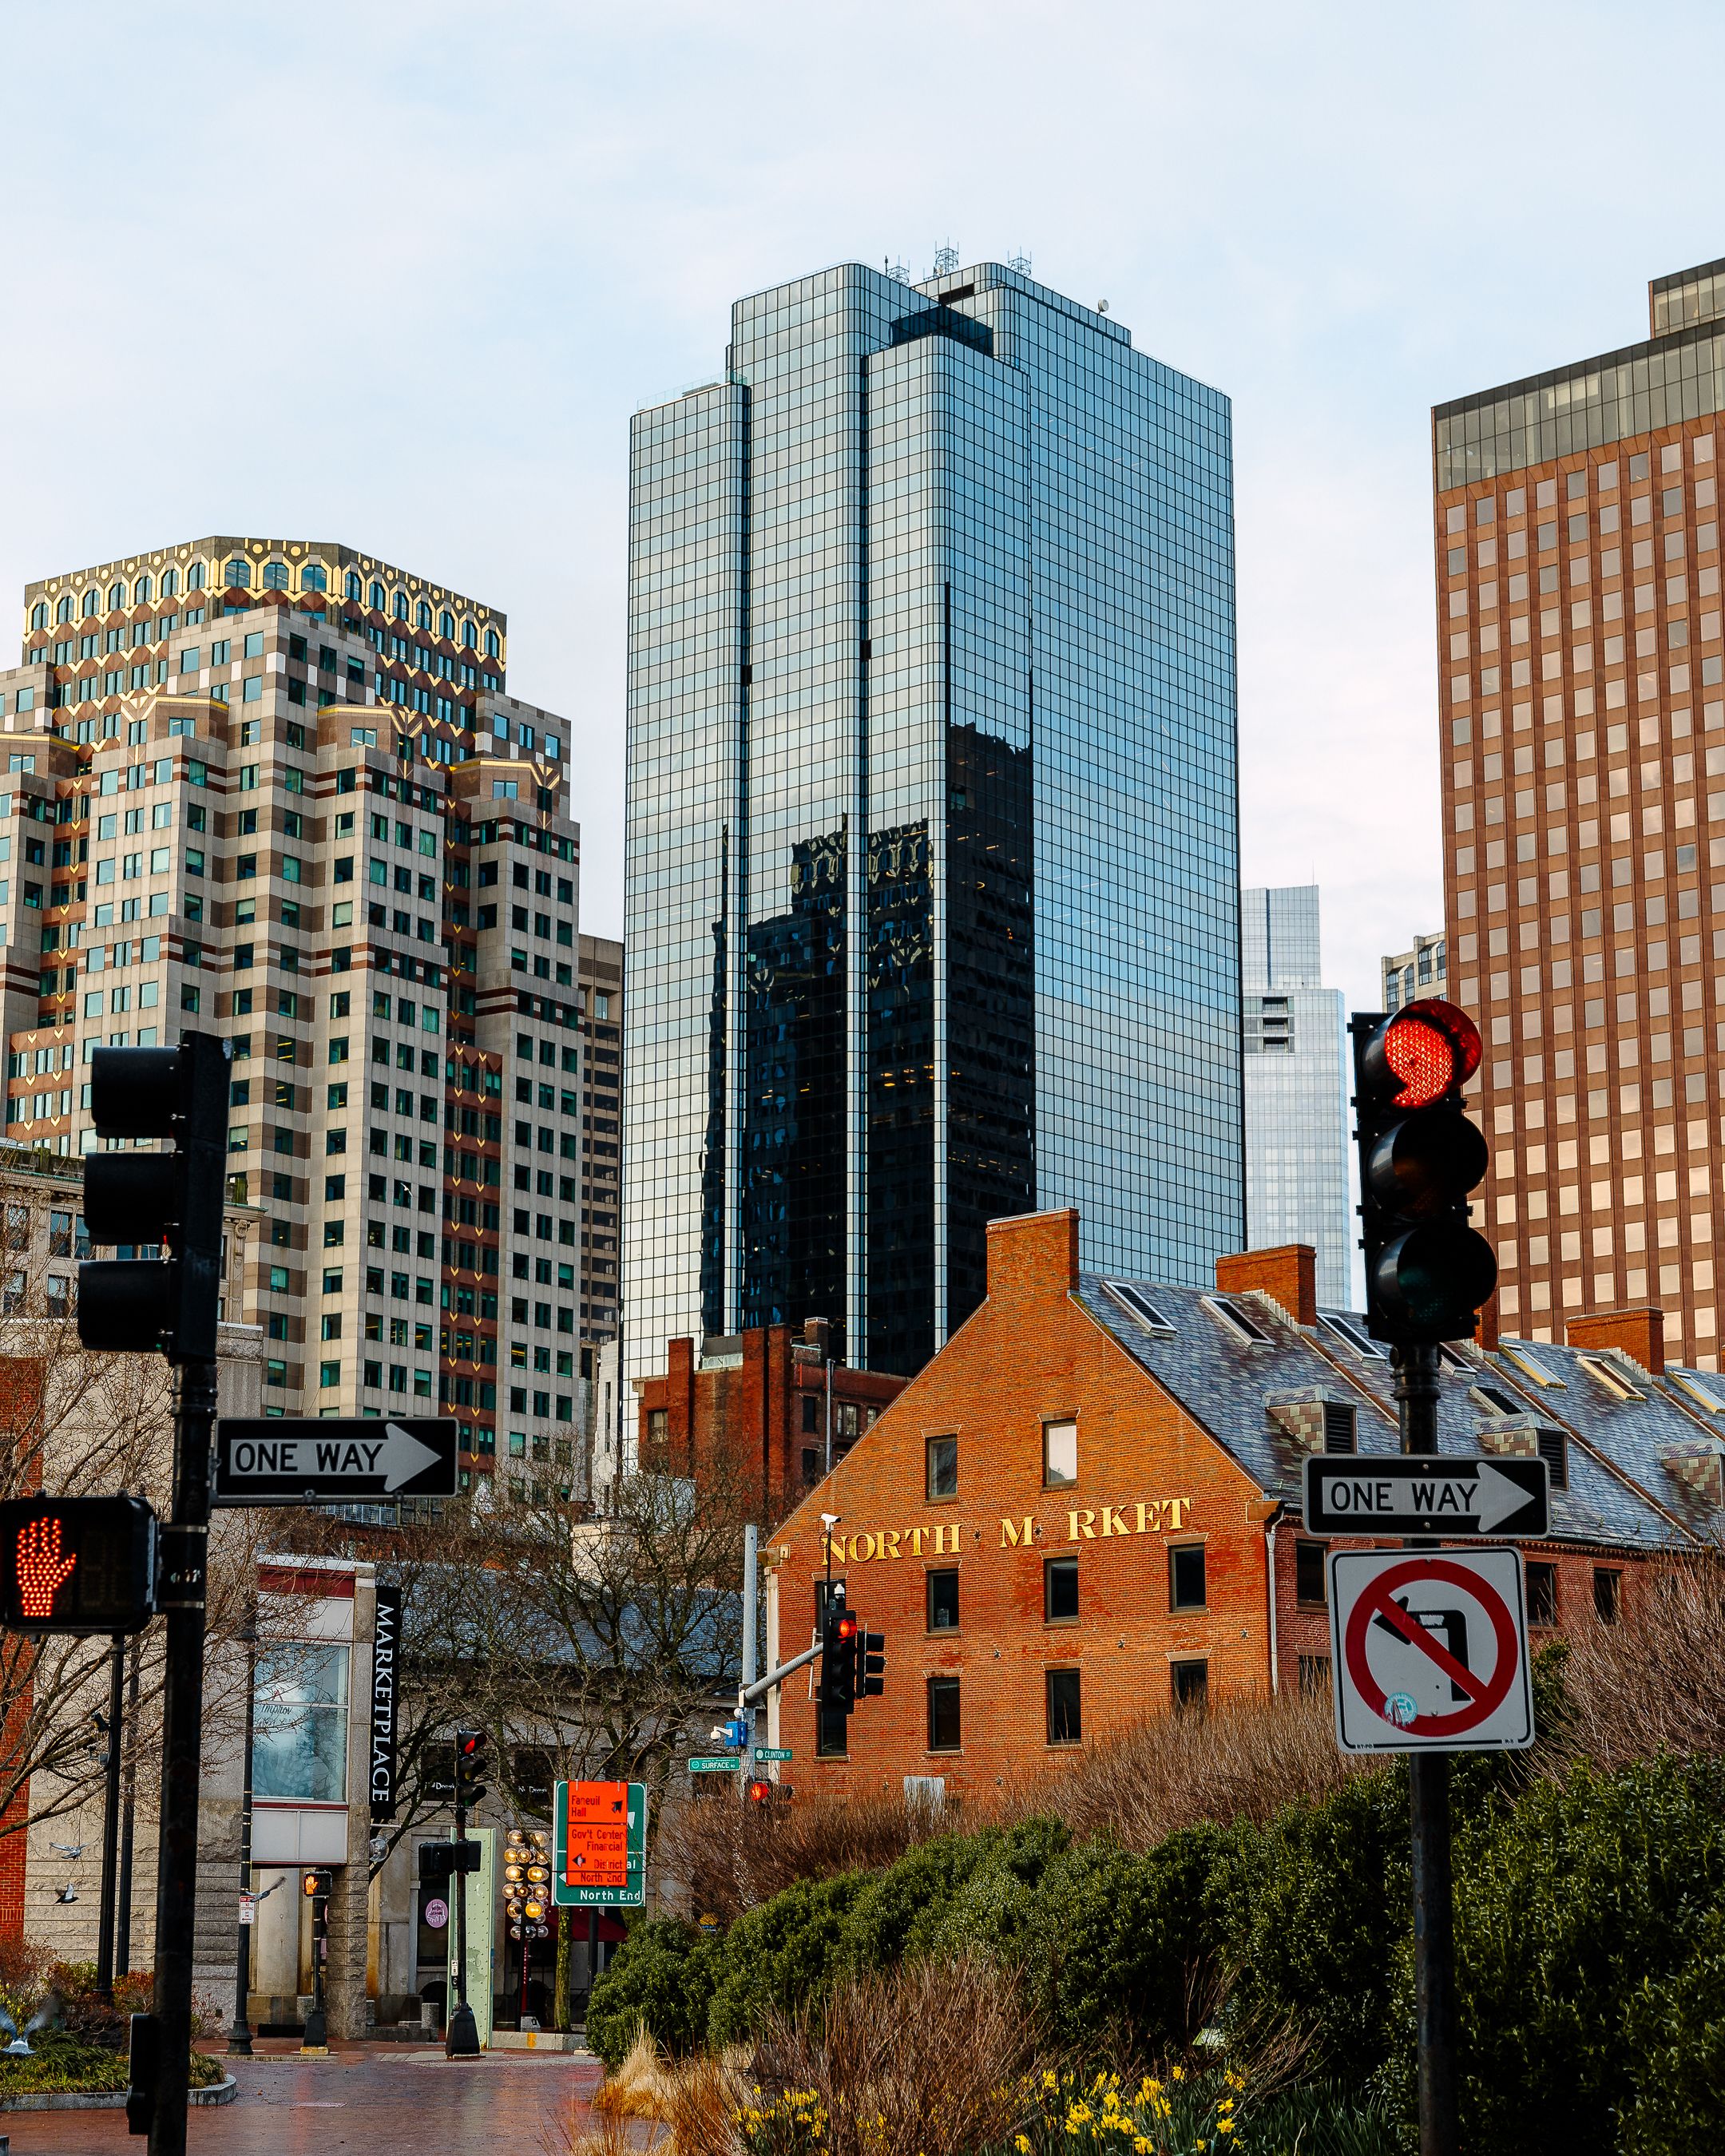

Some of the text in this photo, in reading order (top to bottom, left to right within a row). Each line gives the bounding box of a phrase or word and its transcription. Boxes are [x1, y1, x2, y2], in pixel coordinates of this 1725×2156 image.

[235, 1442, 383, 1472] ONE WAY
[1330, 1481, 1478, 1512] ONE WAY
[821, 1524, 963, 1566] NORTH
[372, 1602, 395, 1801] MARKETPLACE
[764, 1750, 785, 1759] CLINTON
[571, 1795, 601, 1805] Faneuil
[571, 1807, 587, 1817] Hall
[572, 1829, 623, 1840] Gov't Center
[587, 1841, 623, 1852] Financial
[593, 1859, 623, 1869] District
[581, 1873, 622, 1883] North End
[580, 1889, 640, 1900] North End
